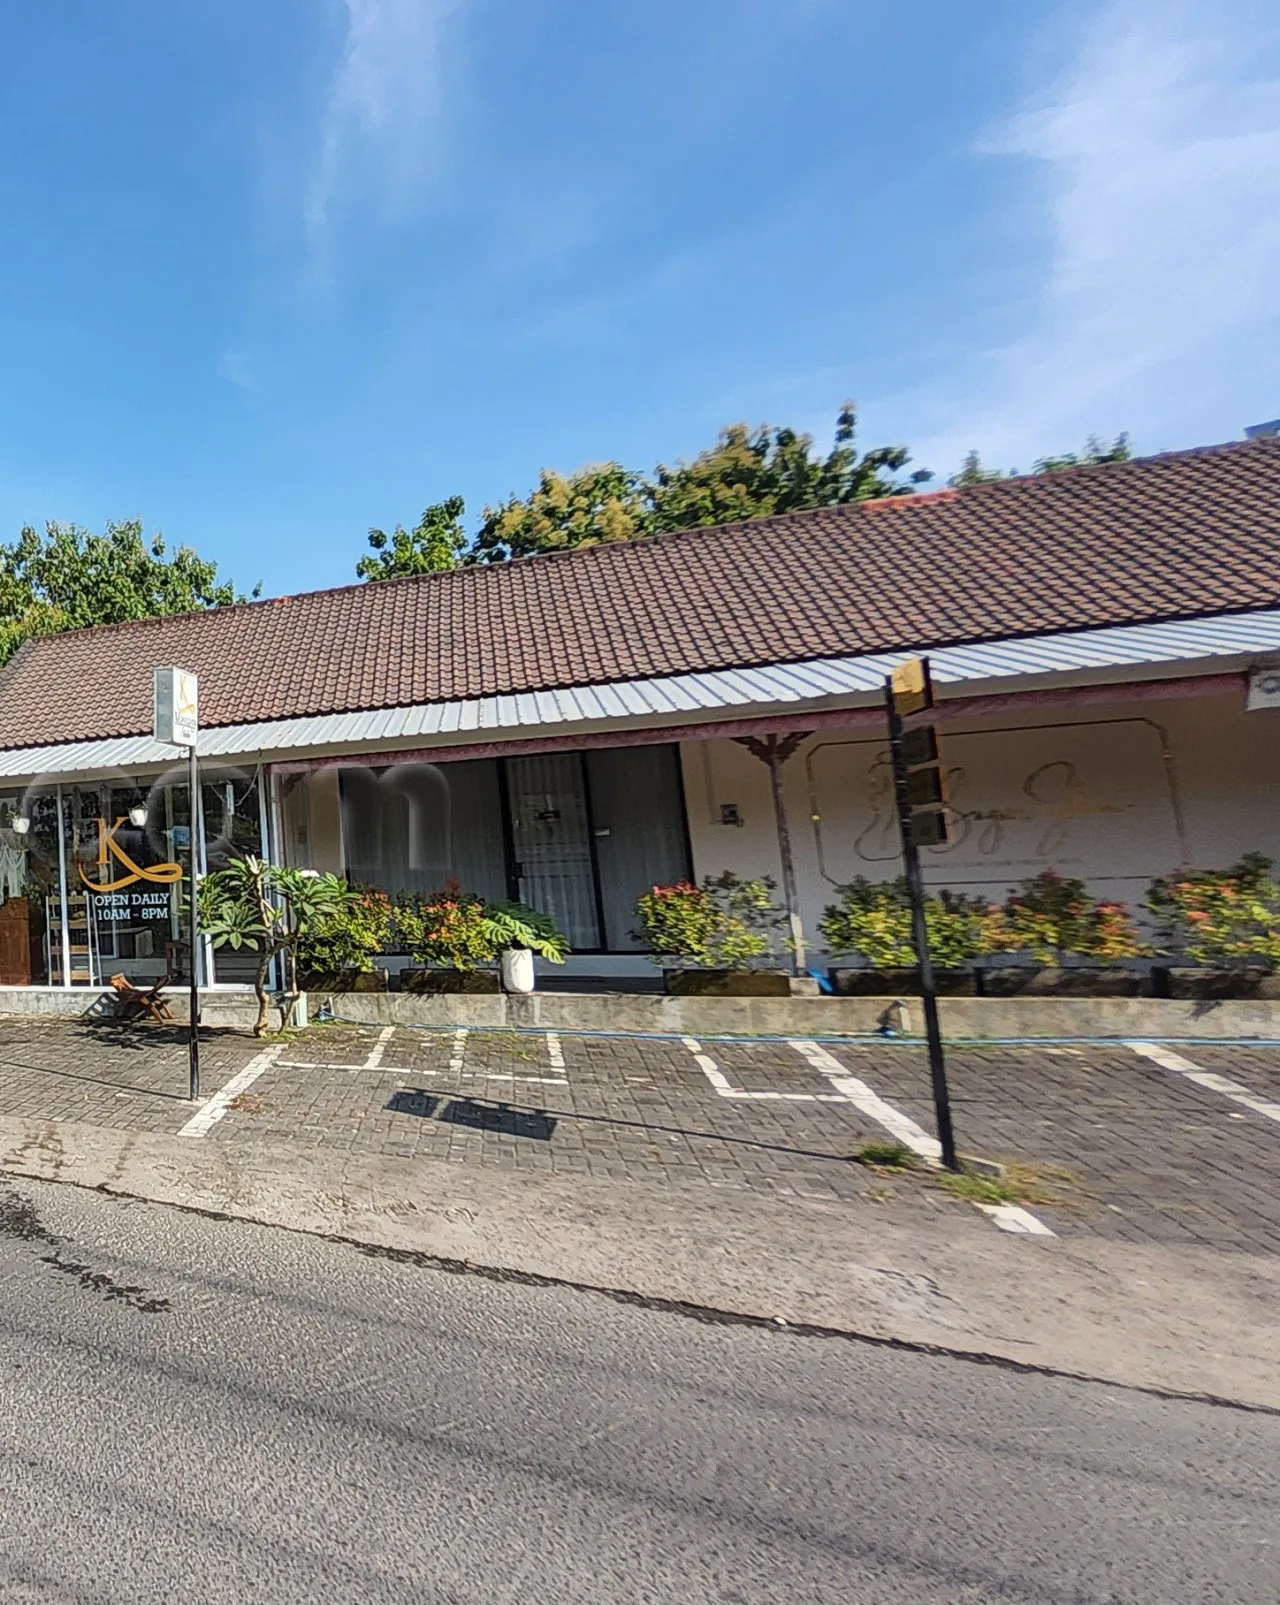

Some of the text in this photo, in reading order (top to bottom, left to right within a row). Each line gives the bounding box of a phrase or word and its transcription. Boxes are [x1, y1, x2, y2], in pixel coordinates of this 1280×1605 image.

[94, 892, 170, 907] OPEN DAILY
[97, 908, 131, 920] 10AM
[141, 907, 169, 919] 8PM
